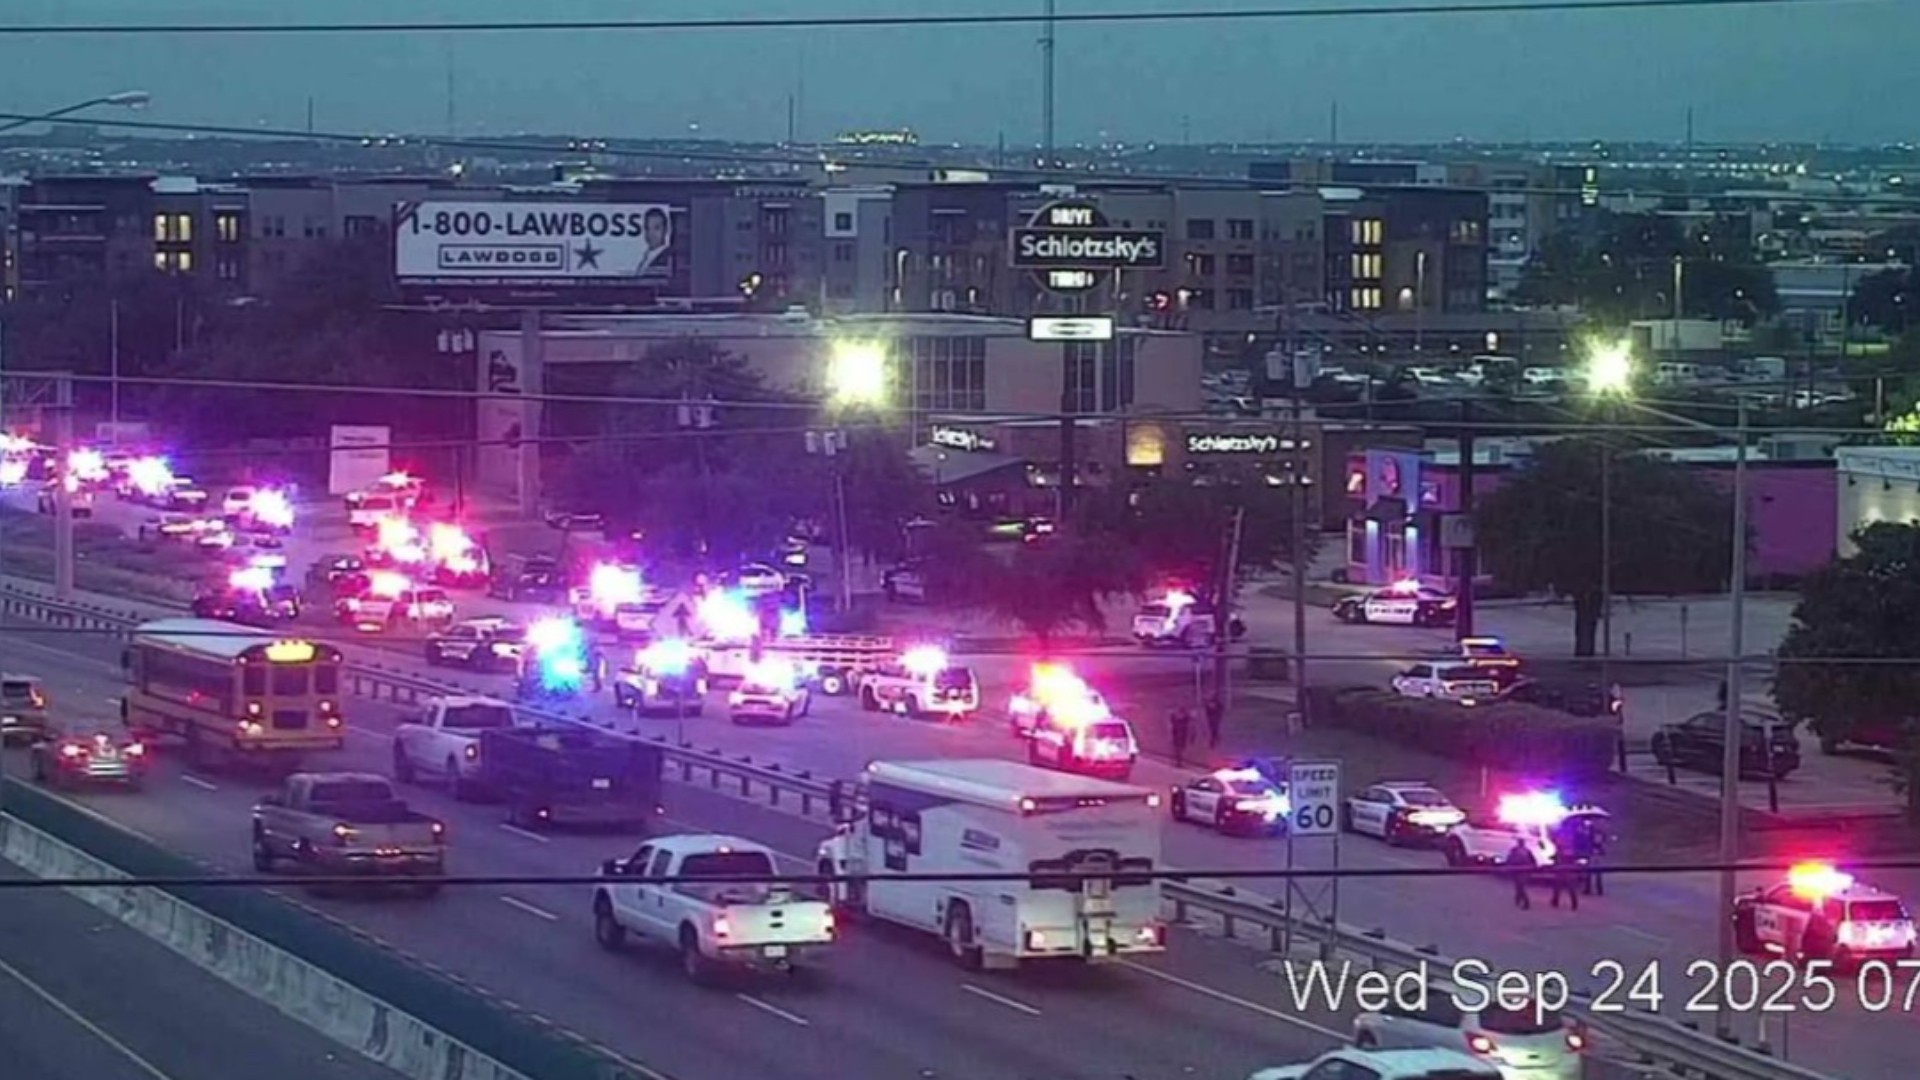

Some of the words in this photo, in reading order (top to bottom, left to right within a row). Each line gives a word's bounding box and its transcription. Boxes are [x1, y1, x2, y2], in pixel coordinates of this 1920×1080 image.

[410, 210, 643, 237] 1-800-LAWBOSS
[1021, 234, 1156, 263] Schlotzsky's
[1294, 769, 1335, 781] SPEED
[1296, 803, 1334, 829] 60
